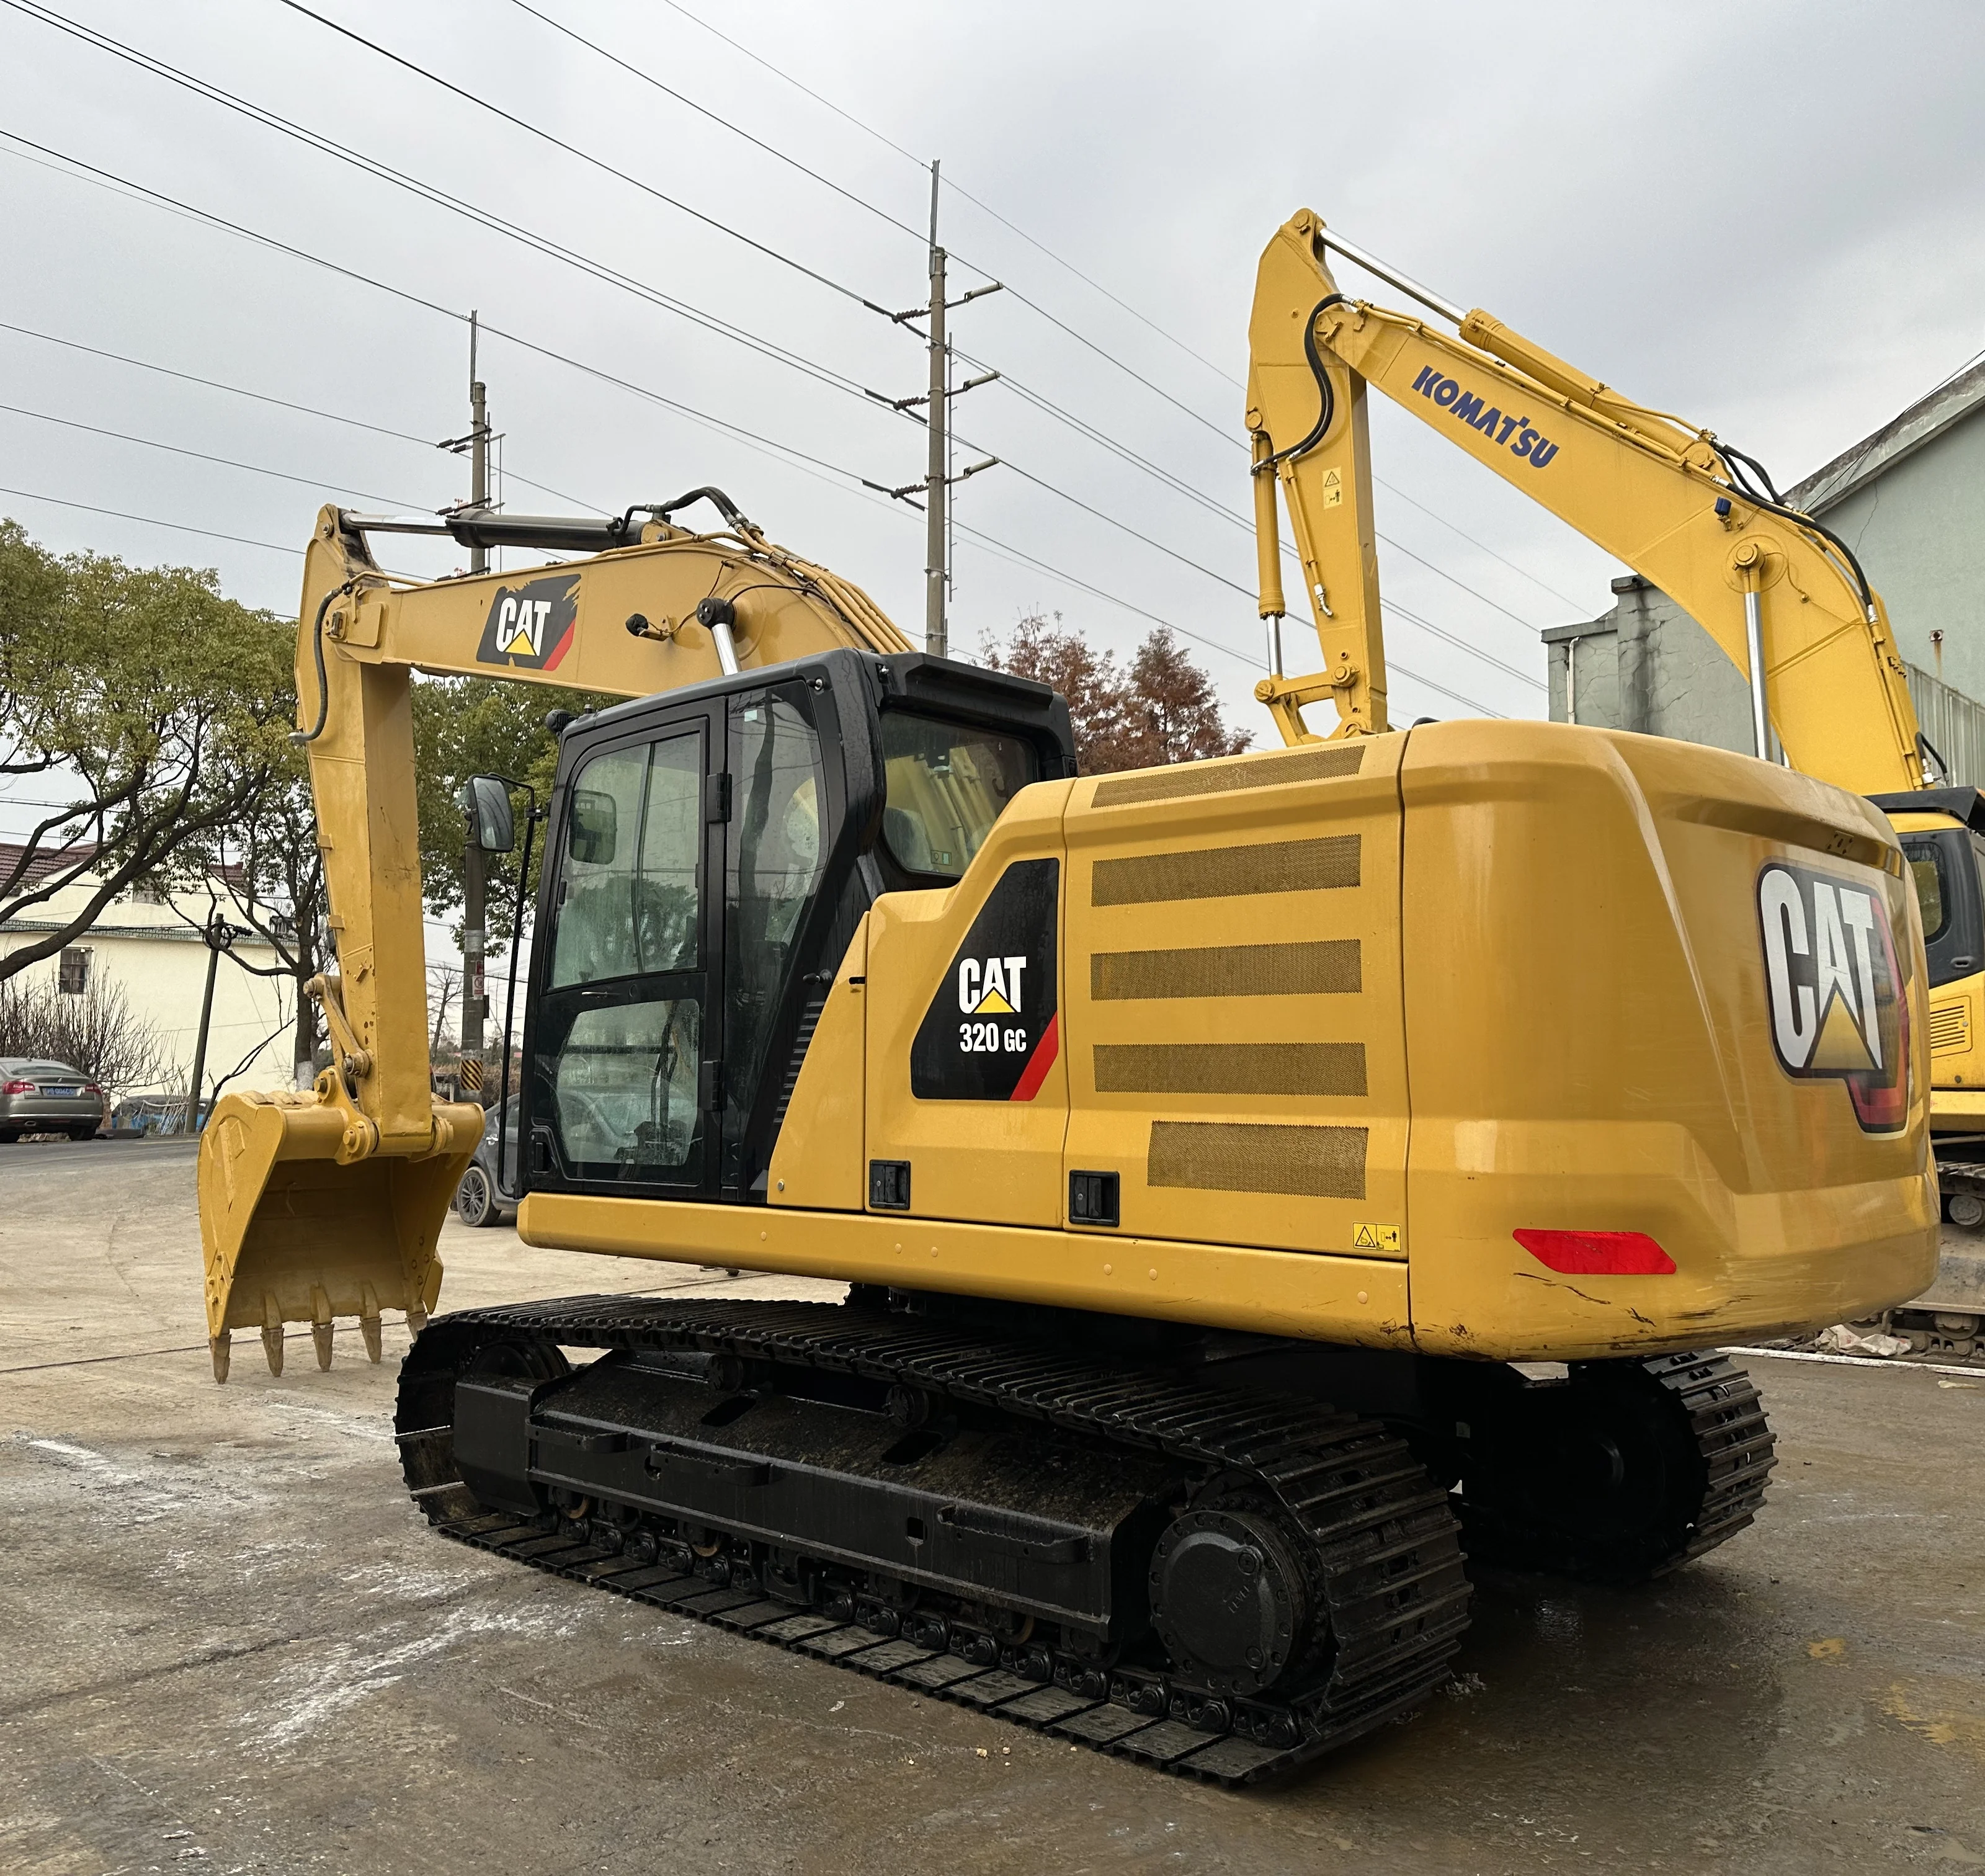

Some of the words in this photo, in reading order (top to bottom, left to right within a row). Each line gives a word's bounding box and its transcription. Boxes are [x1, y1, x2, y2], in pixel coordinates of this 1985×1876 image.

[1411, 365, 1559, 469] KOMATSU
[496, 597, 551, 656] CAT
[958, 956, 1027, 1014] CAT
[1760, 869, 1883, 1070] CAT
[960, 1022, 999, 1053] 320
[1004, 1028, 1027, 1053] GC
